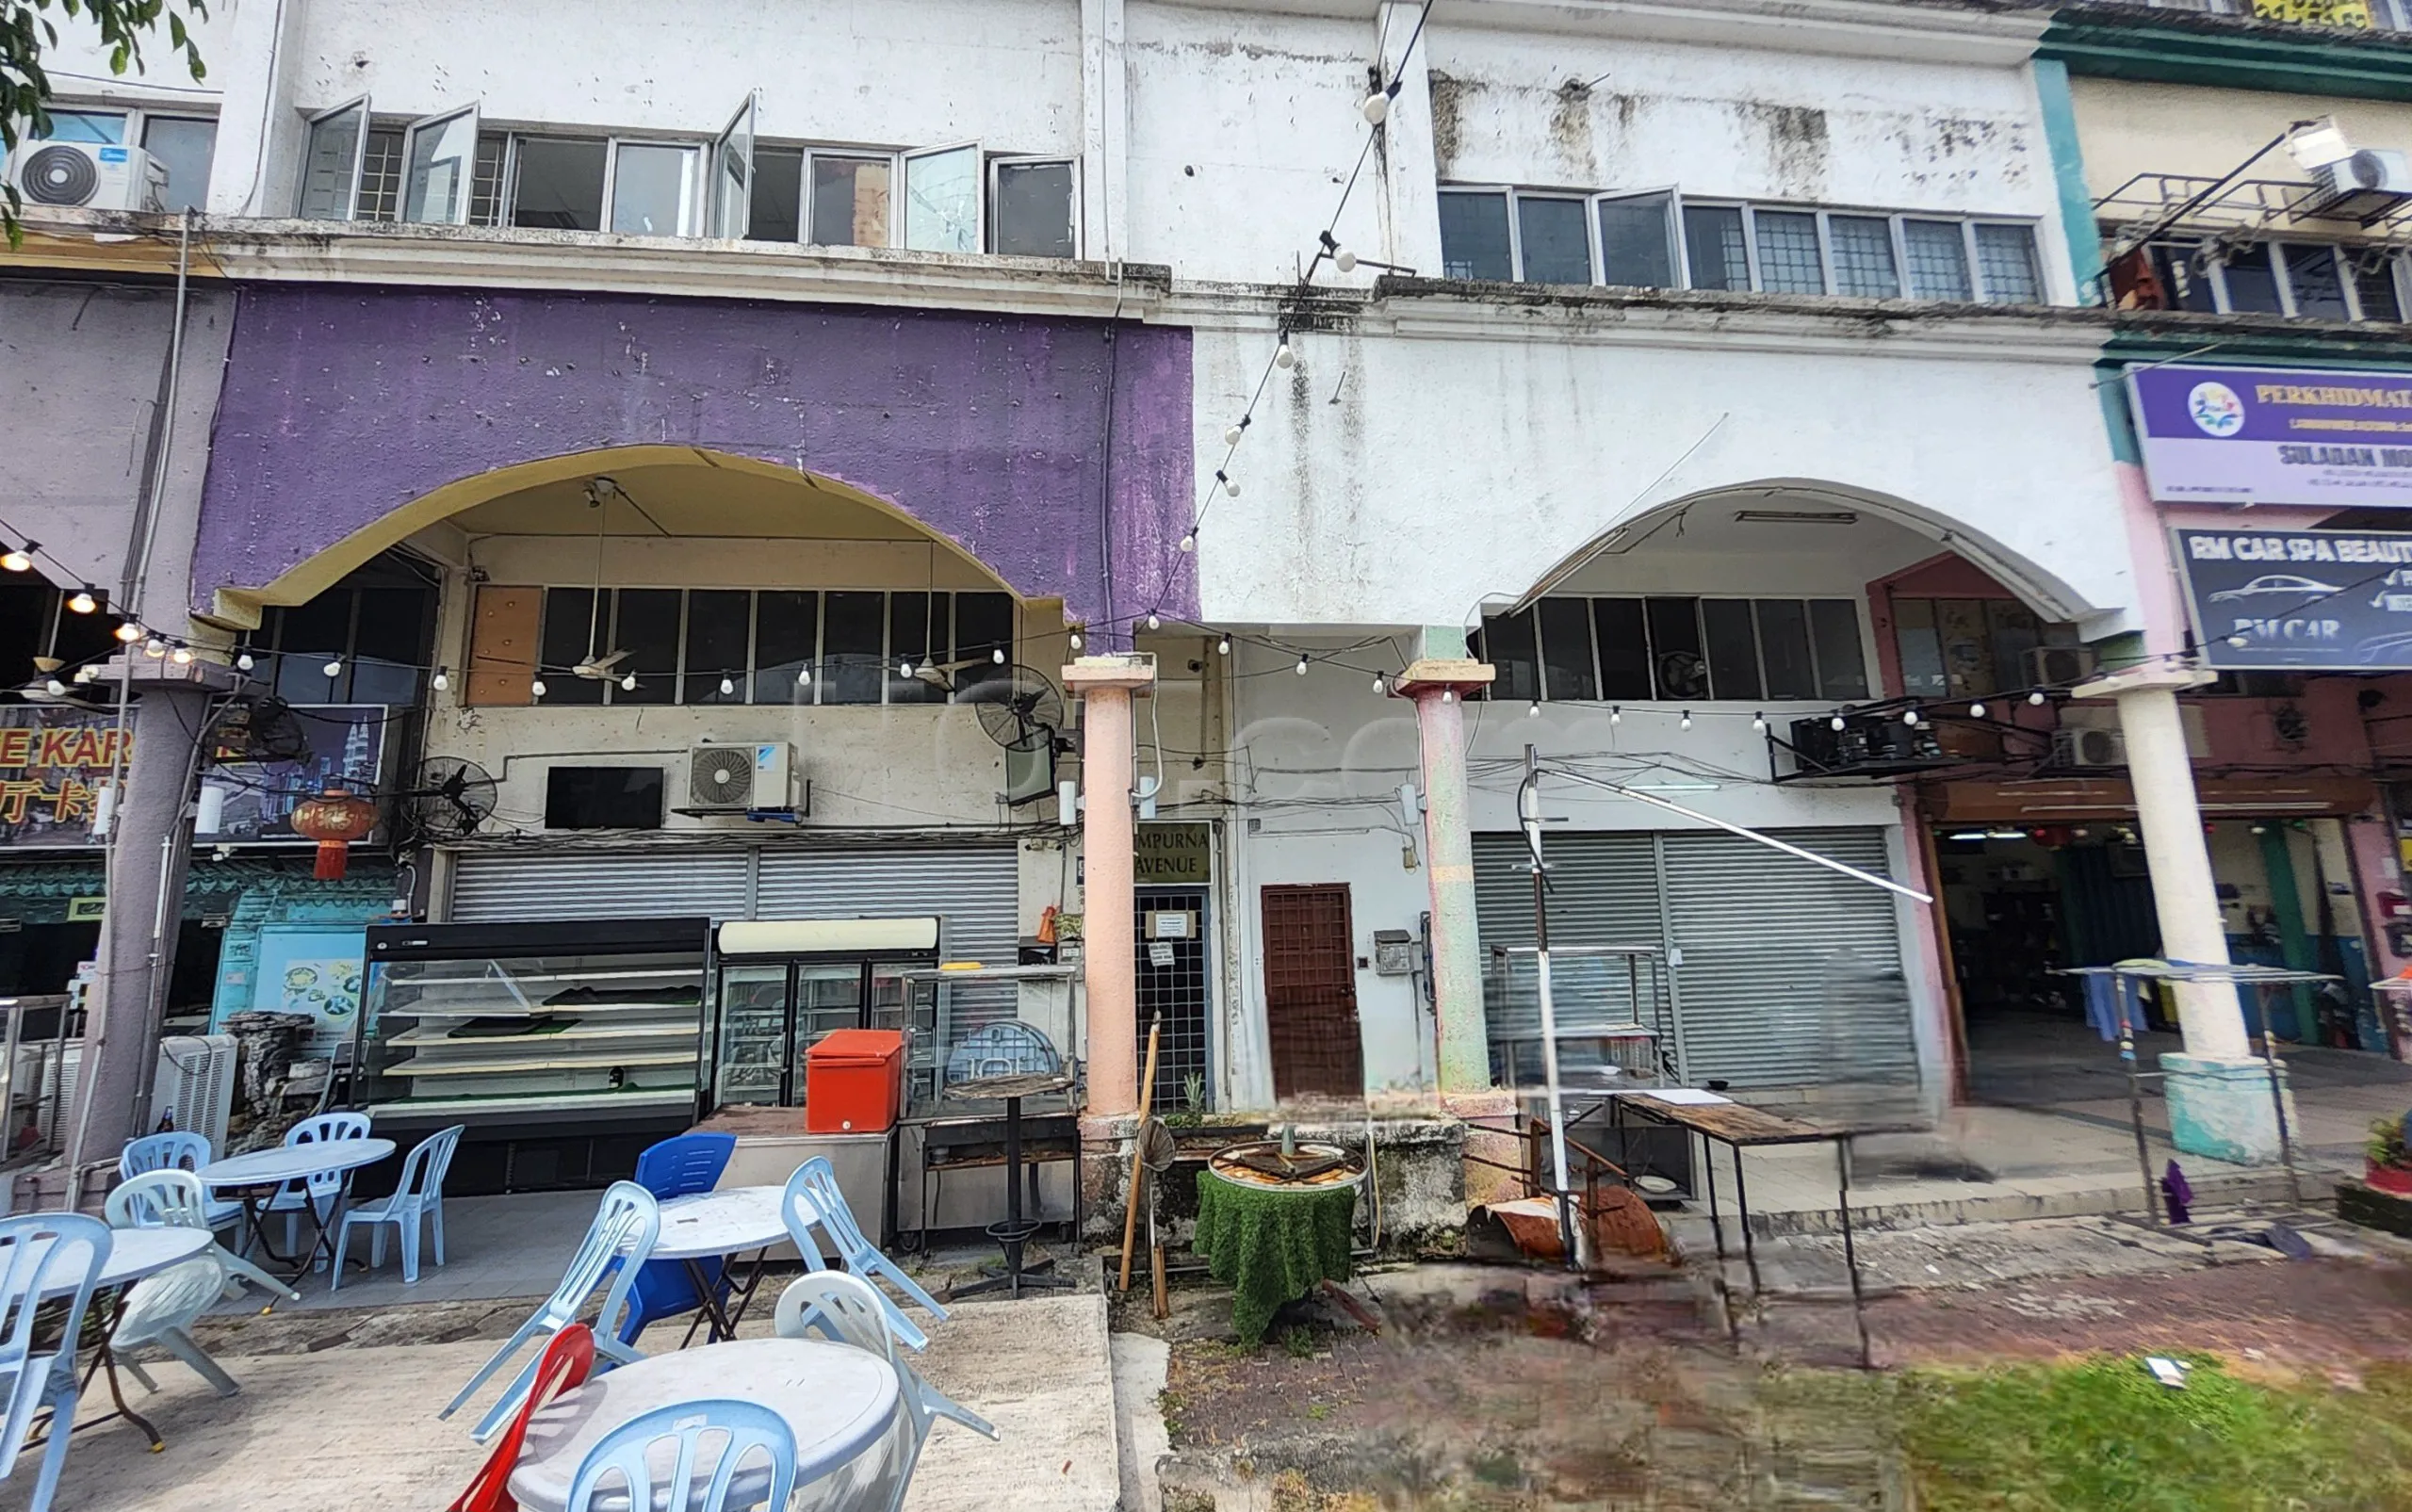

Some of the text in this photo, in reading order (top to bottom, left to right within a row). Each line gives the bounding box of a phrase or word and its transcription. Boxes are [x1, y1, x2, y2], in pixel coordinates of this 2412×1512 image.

[2233, 537, 2289, 561] CAR
[2287, 538, 2336, 561] SPA
[2283, 618, 2340, 641] CAR
[1135, 856, 1198, 873] AVENUE
